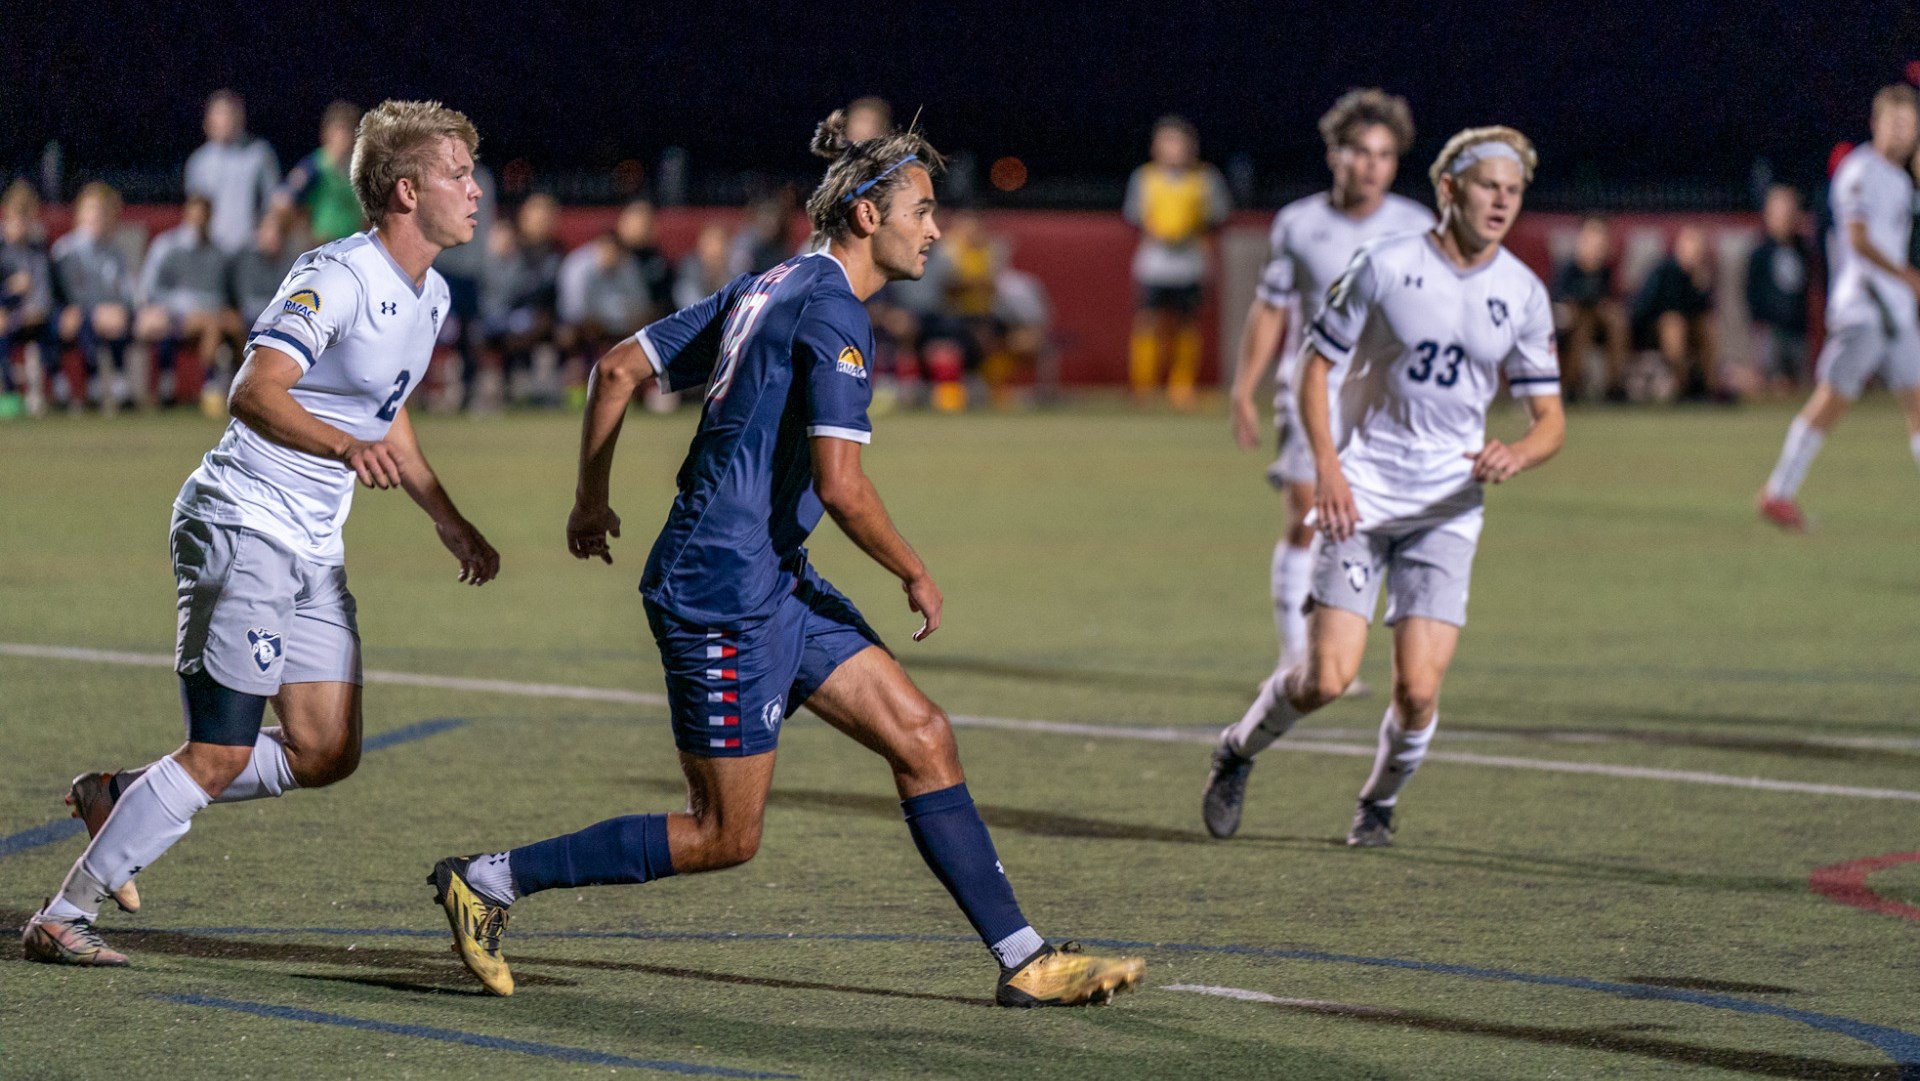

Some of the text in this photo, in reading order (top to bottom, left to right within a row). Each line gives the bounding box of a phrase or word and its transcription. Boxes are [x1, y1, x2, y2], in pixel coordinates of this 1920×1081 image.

[283, 299, 317, 321] RMAC
[1407, 339, 1466, 388] 33
[375, 369, 410, 422] 2
